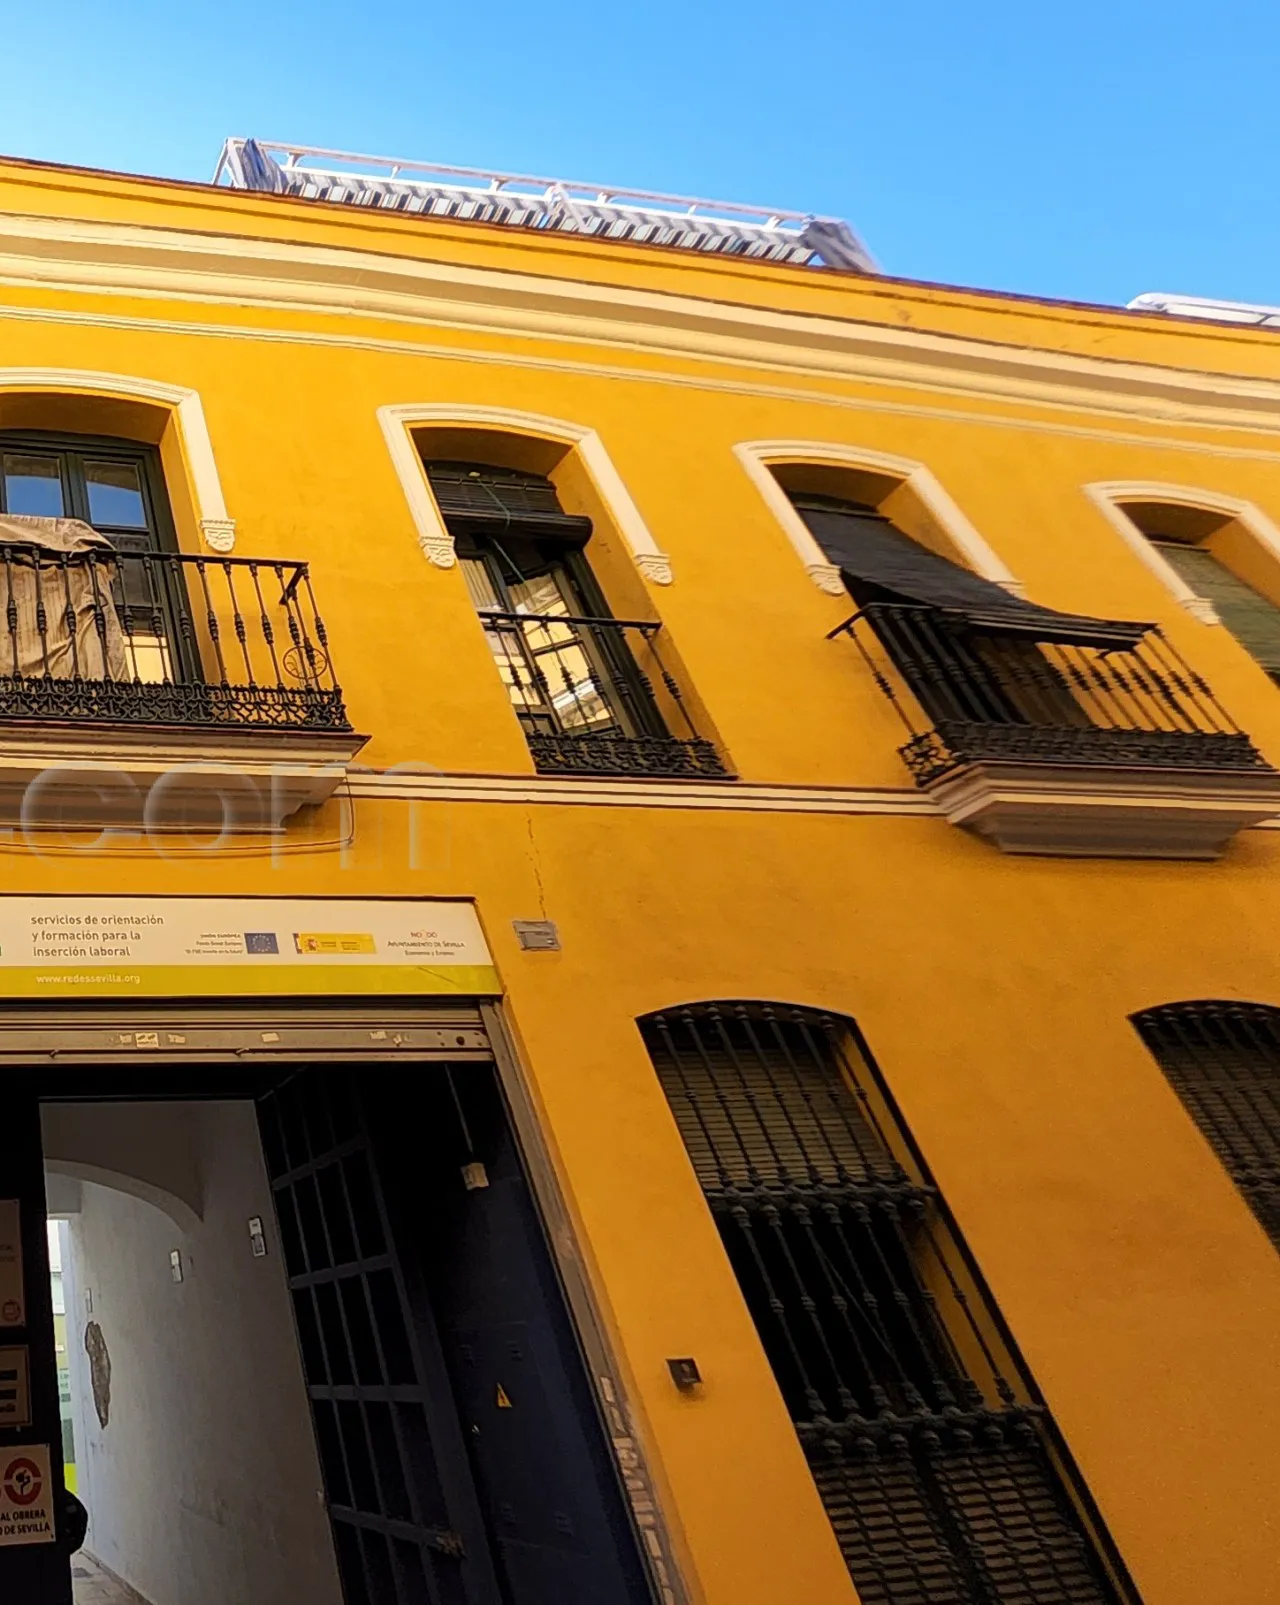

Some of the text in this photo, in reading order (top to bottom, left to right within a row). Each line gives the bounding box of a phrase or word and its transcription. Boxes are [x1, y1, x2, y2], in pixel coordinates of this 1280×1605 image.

[30, 914, 164, 925] servicios de orientación
[31, 930, 141, 942] y formación para la
[33, 946, 131, 957] inserción laboral
[36, 973, 141, 984] www.redessevilla.org
[10, 1508, 46, 1521] OBRERA
[4, 1524, 15, 1535] DE
[17, 1521, 50, 1534] SEVILLA
